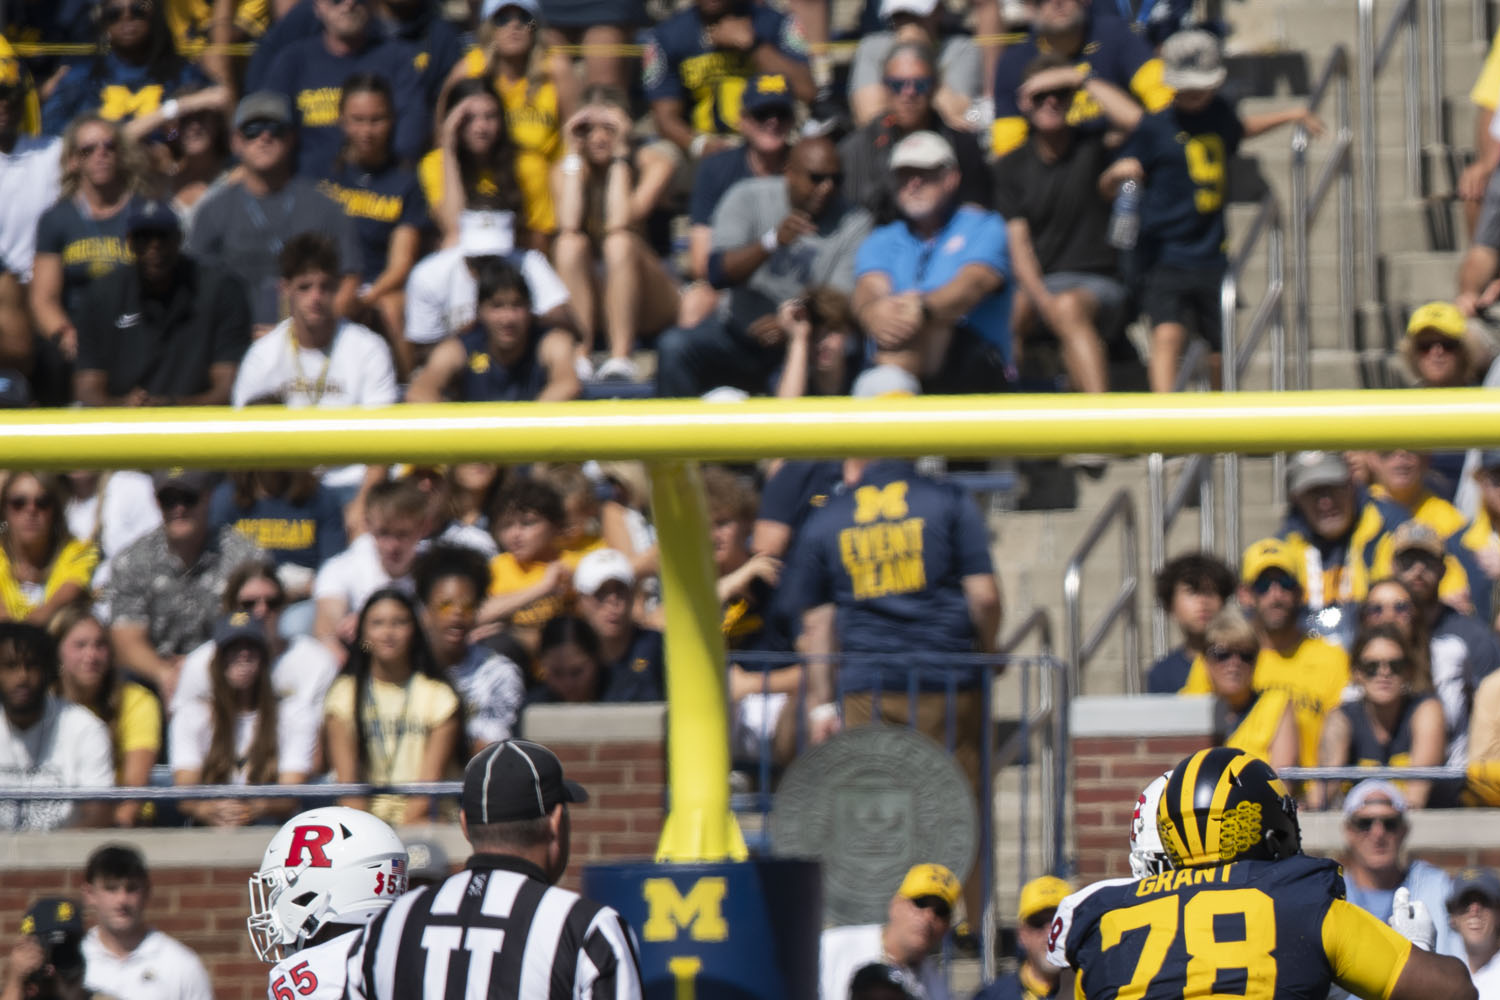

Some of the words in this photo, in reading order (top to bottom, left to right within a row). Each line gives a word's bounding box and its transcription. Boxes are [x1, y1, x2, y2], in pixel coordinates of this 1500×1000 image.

[100, 85, 164, 121] M
[855, 480, 909, 523] M
[840, 517, 924, 562] EVENT
[284, 825, 335, 868] R
[1135, 862, 1238, 897] GRANT
